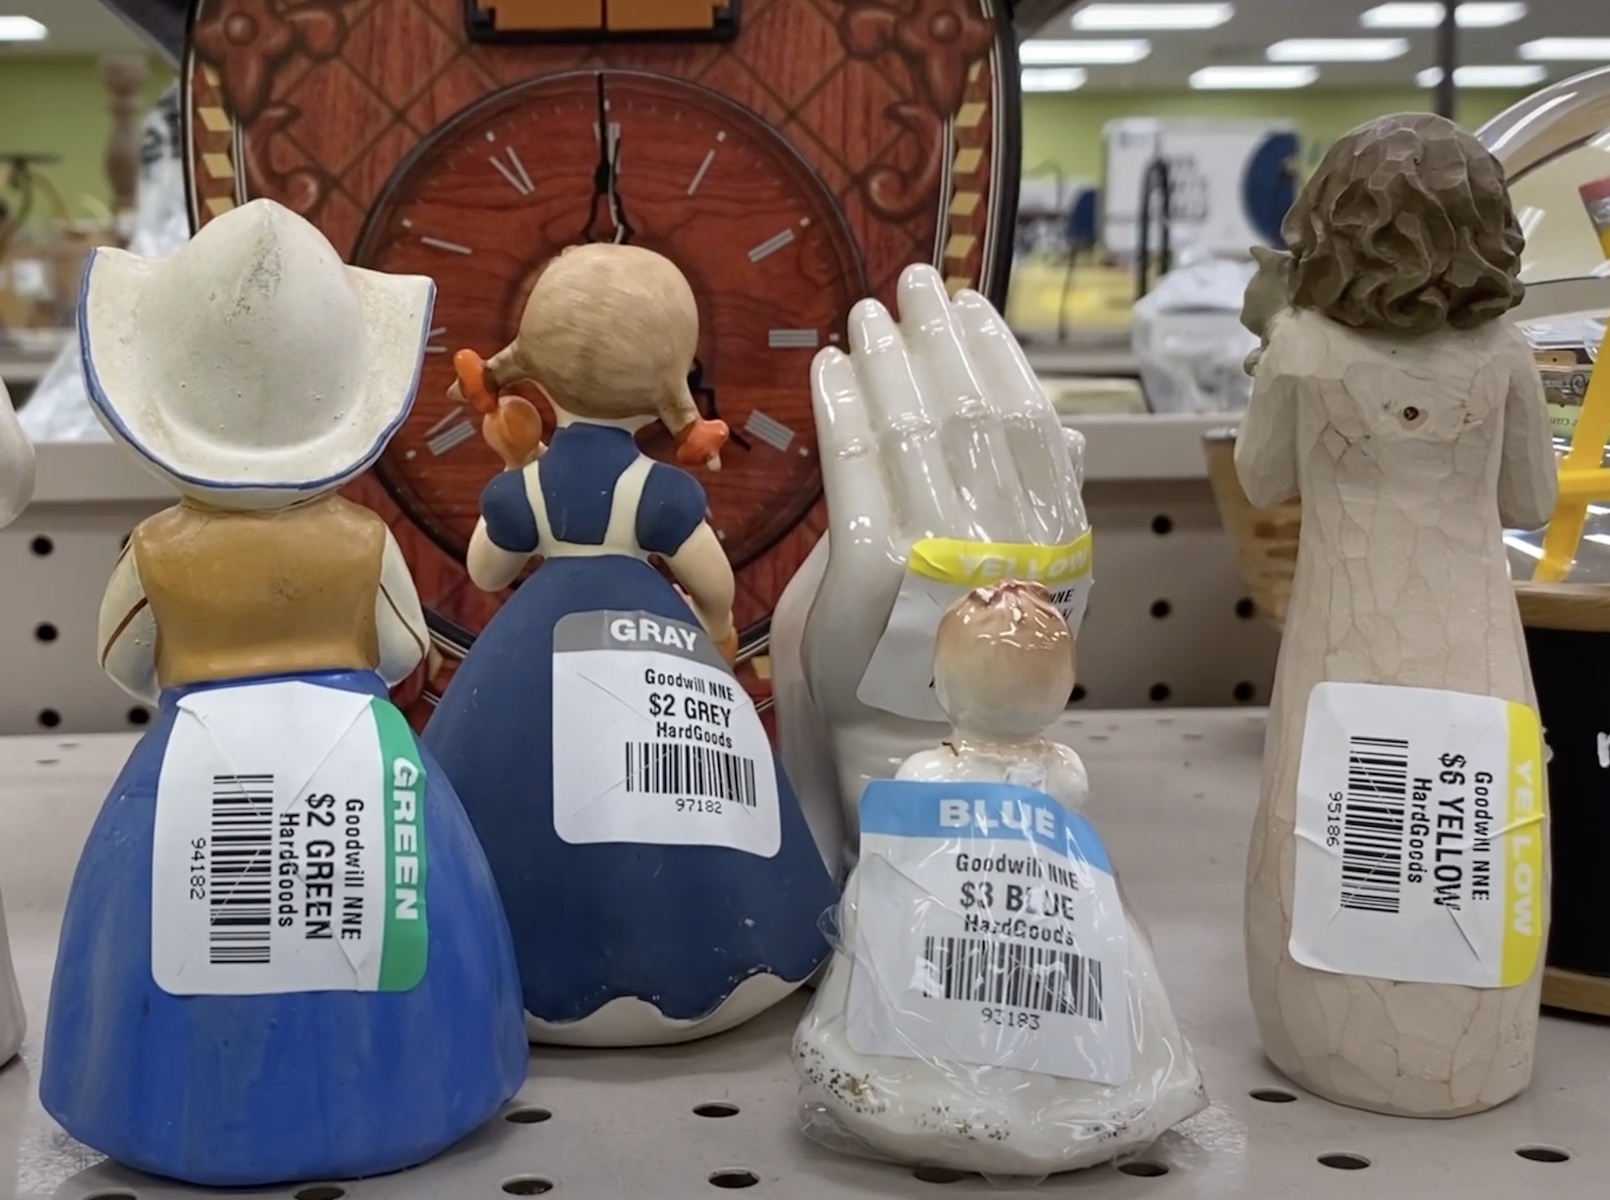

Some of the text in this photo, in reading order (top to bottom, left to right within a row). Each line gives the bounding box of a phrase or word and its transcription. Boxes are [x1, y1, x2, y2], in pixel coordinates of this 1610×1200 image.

[960, 550, 1090, 580] YELLOW
[610, 618, 698, 651] GRAY
[644, 668, 735, 702] Goodwill NNE
[649, 692, 732, 728] $2 GREY
[656, 721, 733, 749] HardGoods
[675, 798, 723, 814] 97182
[939, 798, 1056, 839] BLUE
[1326, 791, 1343, 847] 95186
[393, 757, 420, 920] GREEN
[1408, 777, 1433, 884] HardGoods
[1433, 752, 1467, 911] $6 YELLOW
[1471, 771, 1494, 901] Goodwill NNE
[190, 837, 206, 900] 94182
[278, 813, 301, 928] HardGoods
[305, 793, 336, 940] $2 GREEN
[341, 799, 365, 940] Goodwill NNE
[956, 853, 1079, 891] Goodwill NNE
[960, 881, 994, 910] $3
[965, 914, 1075, 947] HardGoods
[981, 1007, 1040, 1030] 93183
